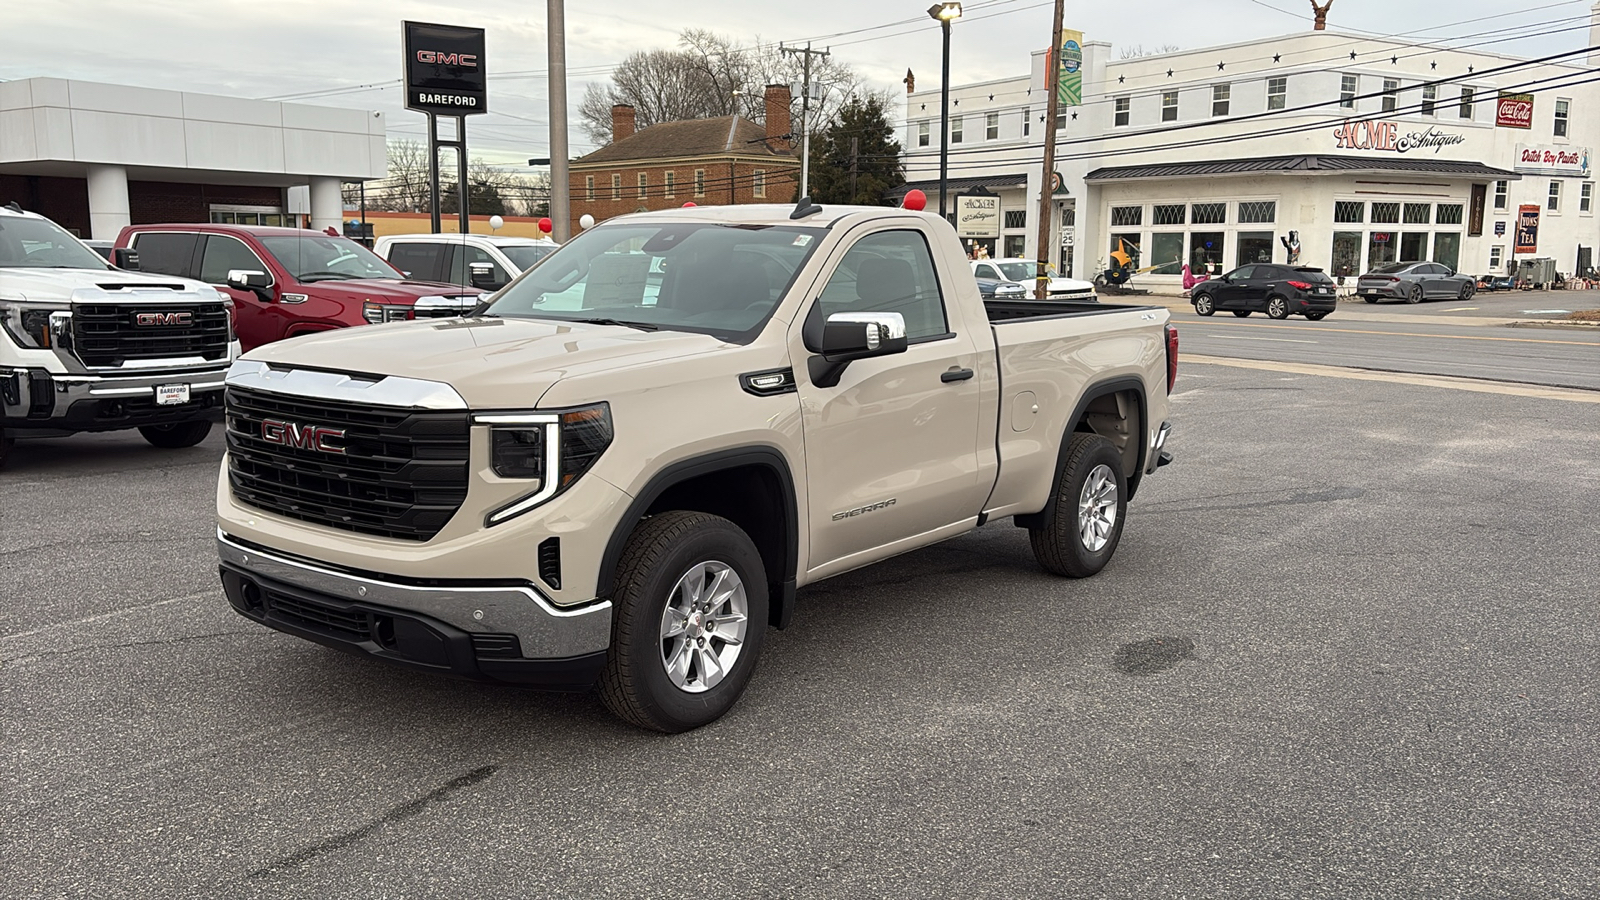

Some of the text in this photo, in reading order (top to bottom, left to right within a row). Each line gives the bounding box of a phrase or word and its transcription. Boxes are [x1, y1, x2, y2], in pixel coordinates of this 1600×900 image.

[417, 50, 477, 67] GMC
[419, 93, 476, 106] BAREFORD
[1334, 120, 1398, 151] ACME
[1411, 125, 1465, 153] Antiques
[1521, 149, 1579, 166] Dutch Boy Paints
[964, 199, 995, 209] ACME
[1063, 236, 1074, 244] 25
[1520, 232, 1534, 244] TEA
[137, 312, 192, 326] GMC
[261, 418, 347, 456] GMC
[831, 497, 897, 521] SIERRA
